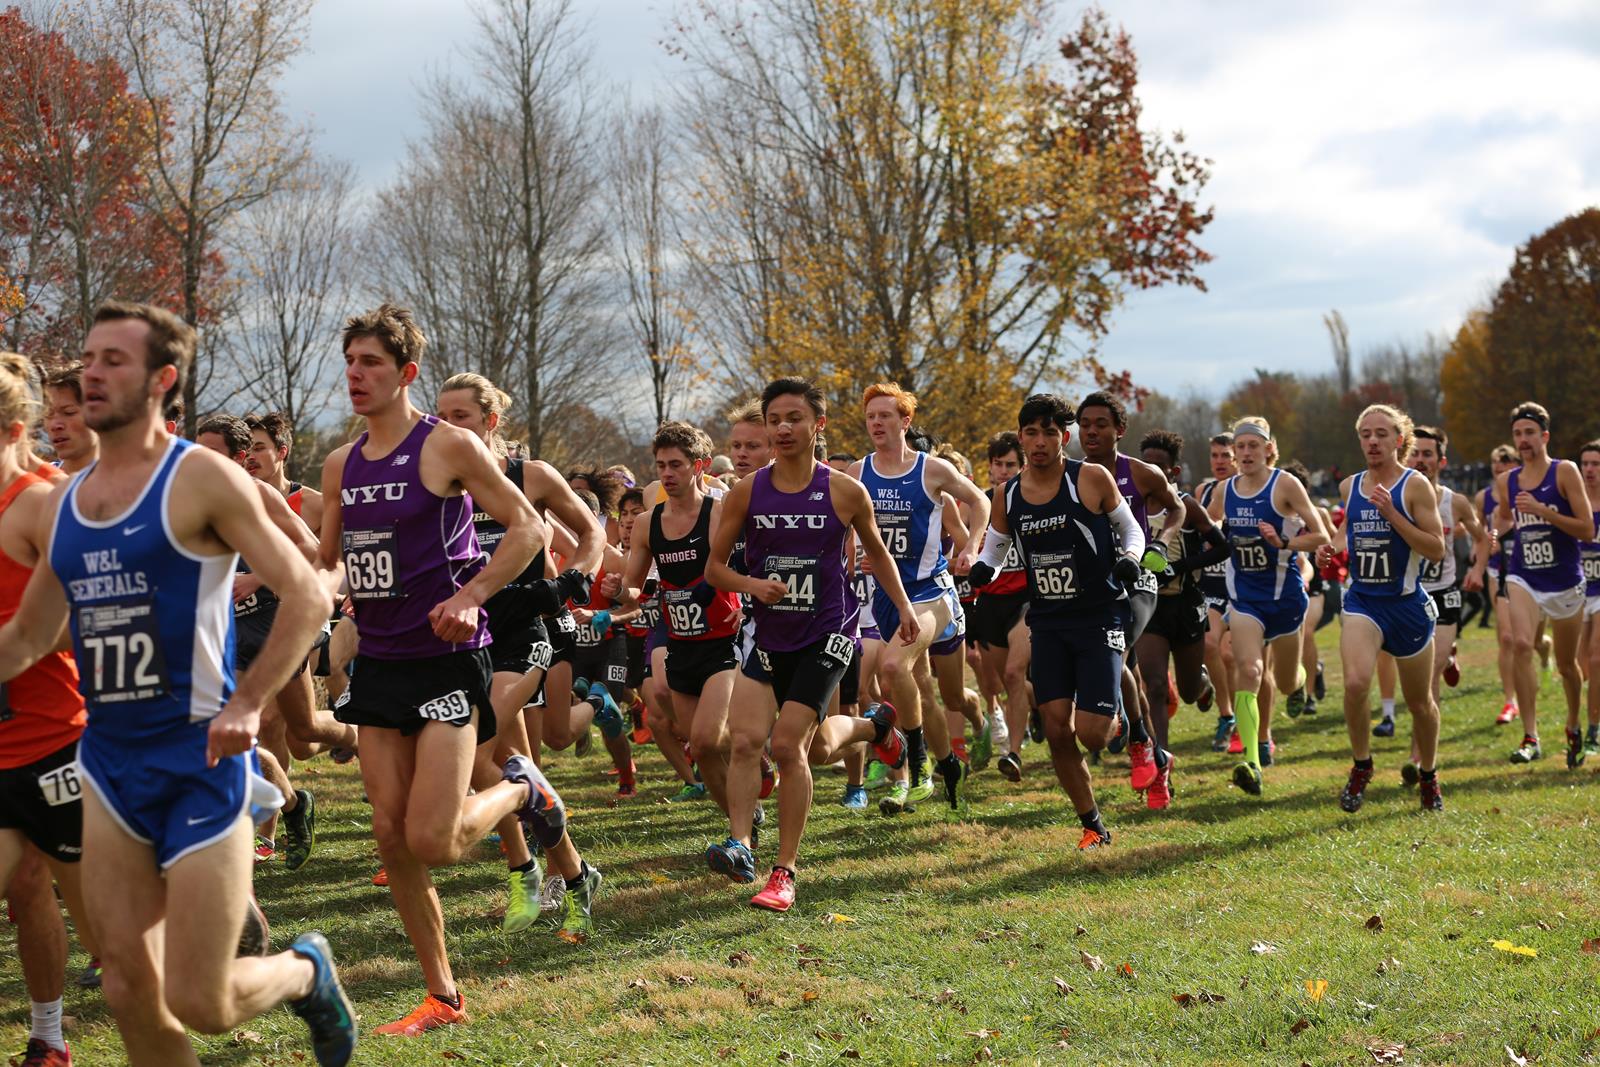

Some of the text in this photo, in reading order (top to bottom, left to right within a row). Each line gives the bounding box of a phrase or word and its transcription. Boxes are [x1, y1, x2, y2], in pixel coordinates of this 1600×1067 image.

[341, 483, 408, 506] NYU
[873, 500, 911, 511] ENERALS
[877, 489, 900, 499] W&L
[753, 515, 827, 529] NYU
[1021, 514, 1066, 531] EMORY
[1236, 508, 1254, 517] W&L
[1361, 510, 1380, 520] W&L
[1353, 522, 1391, 533] GENERALS
[880, 528, 908, 553] 75
[82, 549, 122, 574] W&L
[659, 549, 697, 564] RHODES
[1236, 546, 1268, 567] 773
[1356, 552, 1390, 577] 771
[1523, 542, 1553, 564] 589
[347, 551, 393, 590] 639
[1035, 567, 1076, 594] 562
[69, 572, 149, 602] GENERALS
[768, 573, 815, 604] 44
[668, 603, 705, 630] 692
[83, 632, 160, 691] 772
[425, 693, 464, 720] 639
